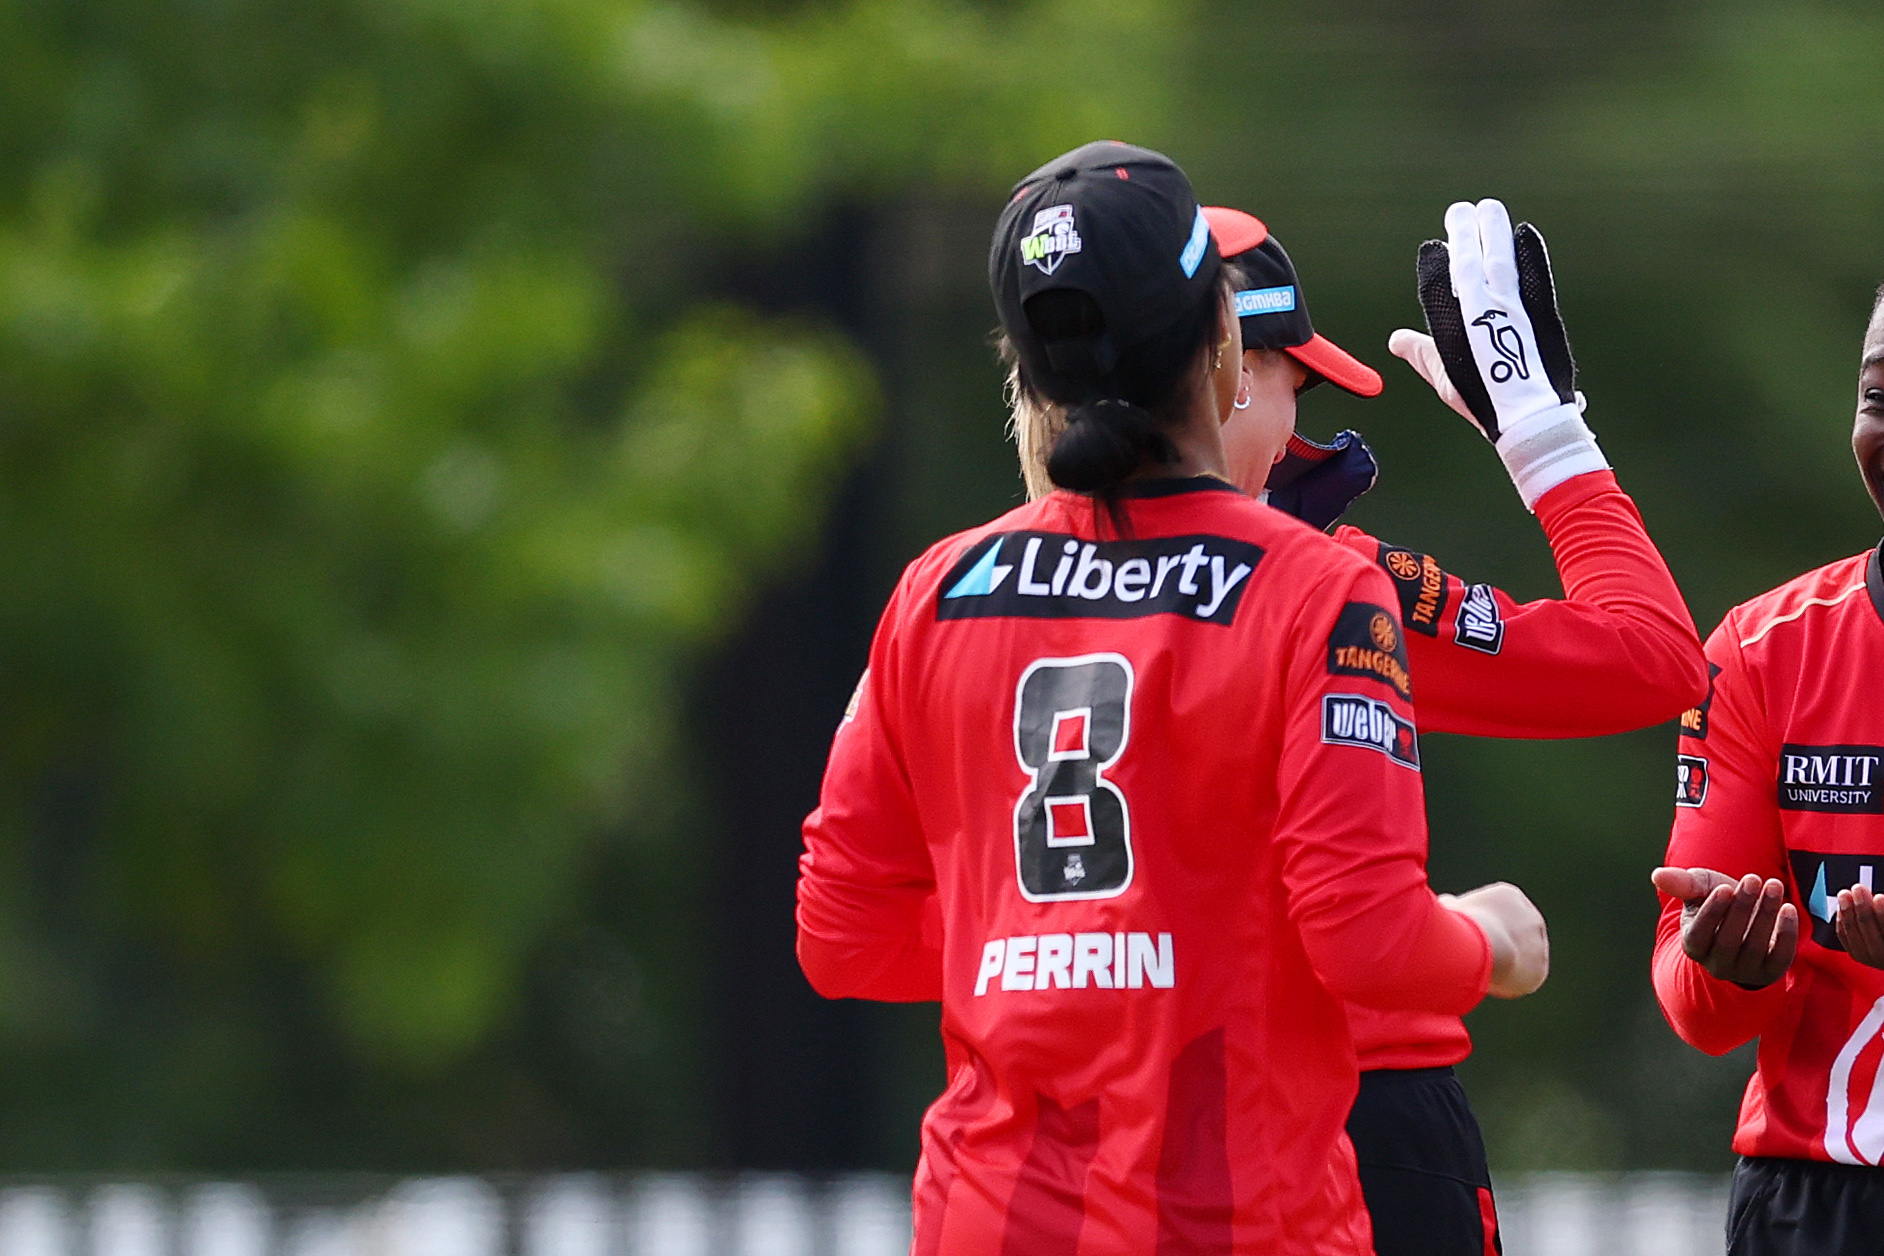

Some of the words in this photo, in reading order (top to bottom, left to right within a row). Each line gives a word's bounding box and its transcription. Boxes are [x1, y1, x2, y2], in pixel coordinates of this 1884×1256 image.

[1017, 536, 1252, 617] Liberty
[1332, 700, 1397, 752] weber
[1013, 652, 1135, 902] 8
[1784, 754, 1879, 787] RMIT
[1787, 788, 1872, 804] UNIVERSITY
[973, 932, 1176, 997] PERRIN
